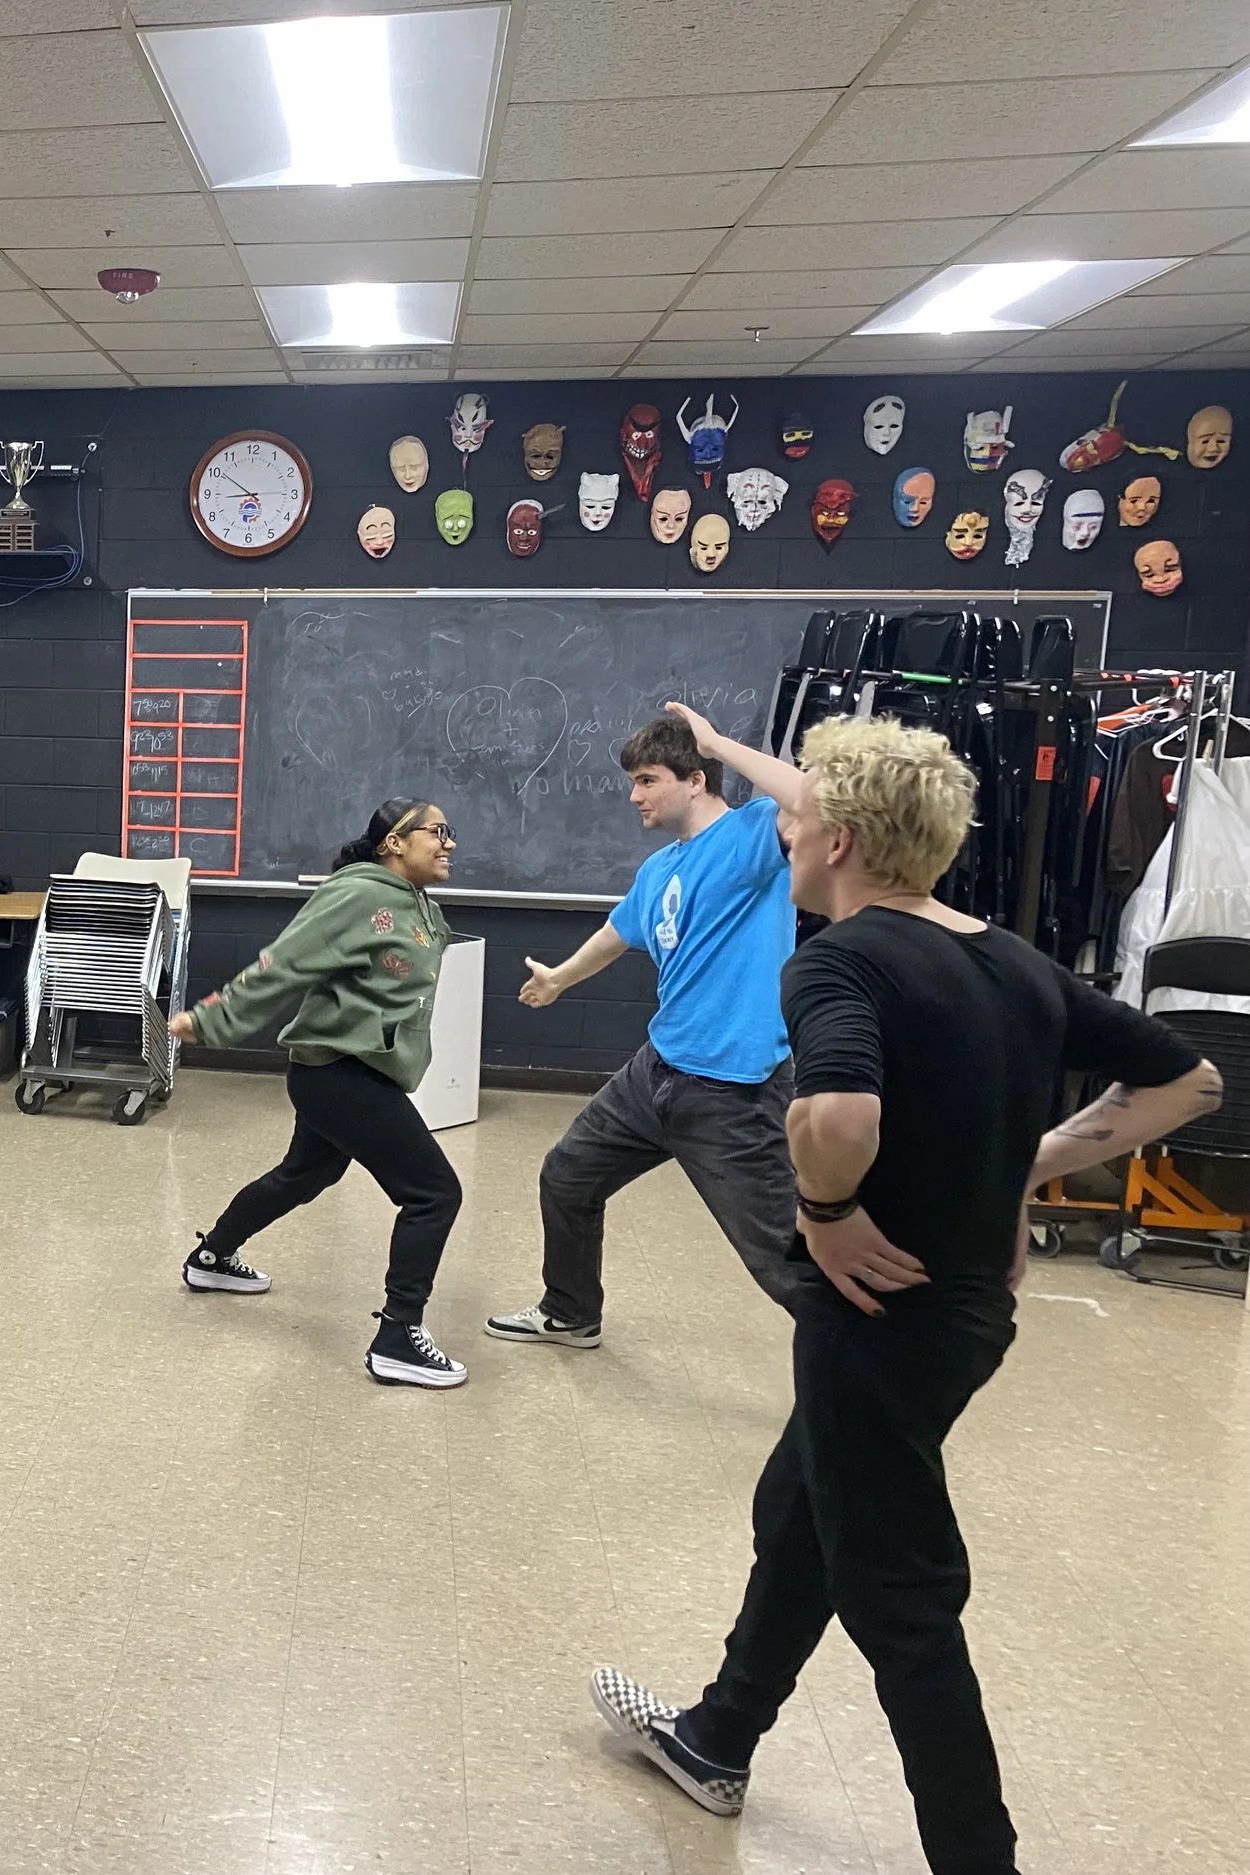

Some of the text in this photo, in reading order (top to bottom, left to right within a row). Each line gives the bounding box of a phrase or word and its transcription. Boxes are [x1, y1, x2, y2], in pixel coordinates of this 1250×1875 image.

[247, 445, 260, 455] 12
[224, 452, 236, 462] 11
[272, 451, 277, 461] 1
[208, 468, 221, 478] 10
[287, 468, 294, 478] 2
[204, 489, 211, 499] 9
[291, 490, 298, 500] 3
[209, 512, 216, 522] 8
[284, 512, 290, 522] 4
[223, 529, 230, 539] 7
[245, 533, 252, 543] 6
[267, 529, 275, 539] 5
